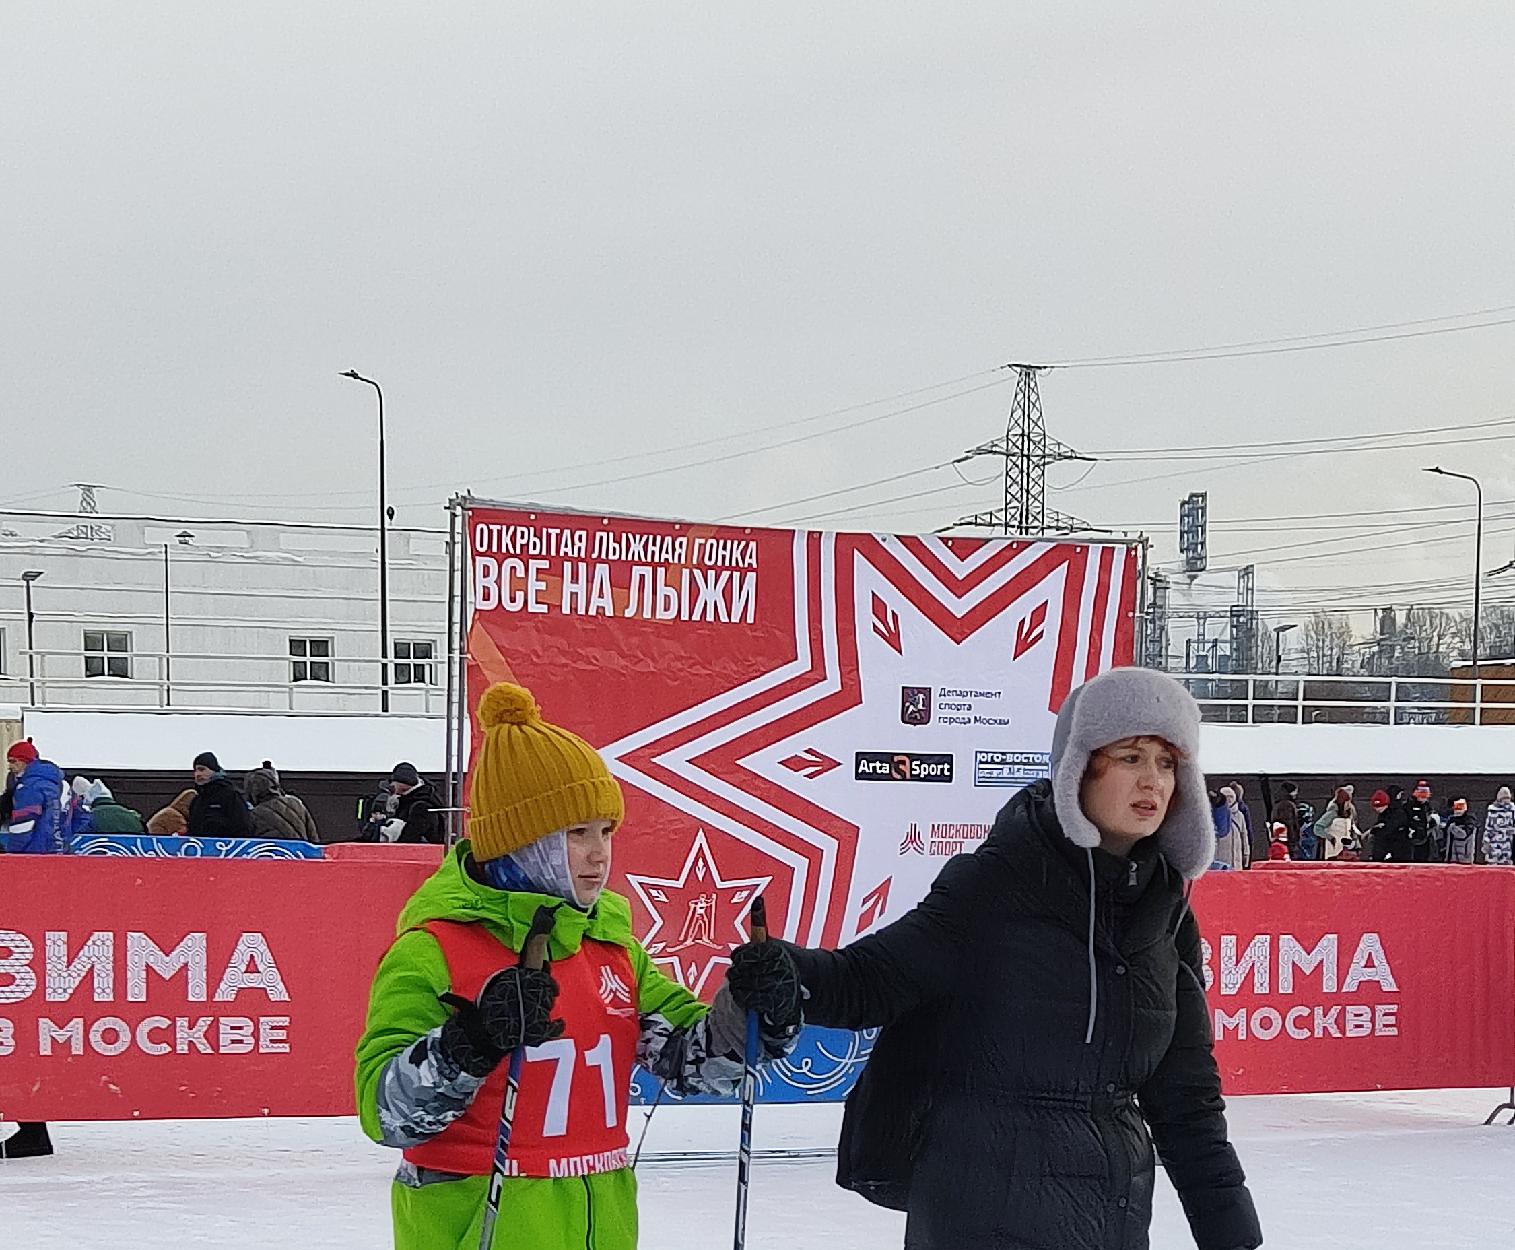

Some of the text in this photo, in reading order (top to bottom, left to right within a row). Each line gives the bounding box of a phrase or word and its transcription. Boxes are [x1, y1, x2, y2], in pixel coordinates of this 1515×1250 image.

[475, 523, 758, 568] ОТКРЫТАЯ ЛЫЖНАЯ ГОНКА
[474, 556, 757, 624] ВСЕ НА ЛЫЖИ
[938, 687, 1002, 699] Департамент
[938, 702, 972, 711] спорта
[973, 716, 1010, 726] Москвы
[858, 760, 951, 778] Arta Sport
[929, 840, 965, 856] СПОРТ
[37, 1016, 291, 1057] МОСКВЕ
[1213, 1004, 1399, 1042] МОСКВЕ
[524, 1033, 618, 1137] 71
